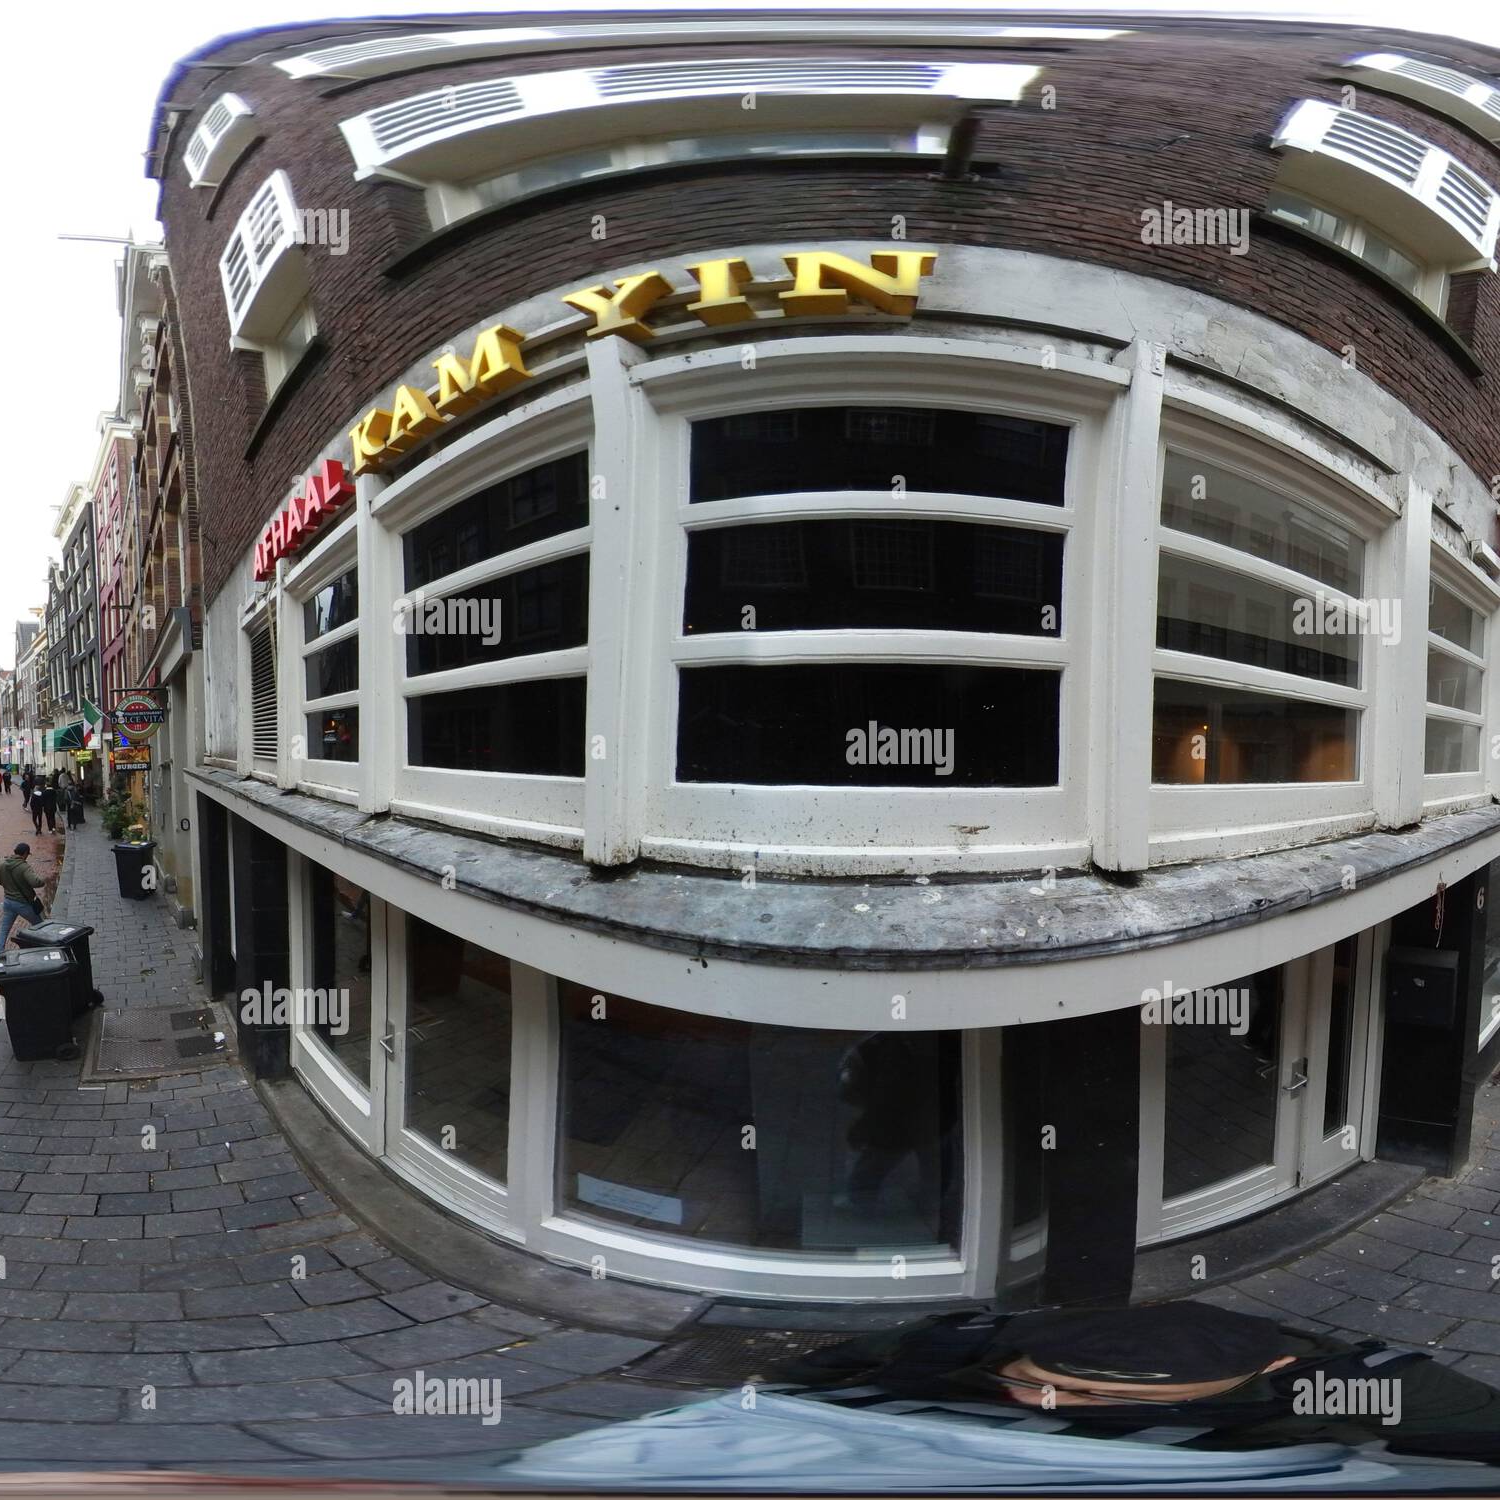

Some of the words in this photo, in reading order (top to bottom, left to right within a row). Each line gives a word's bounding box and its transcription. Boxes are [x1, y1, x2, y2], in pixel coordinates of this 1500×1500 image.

[349, 324, 535, 474] KAM
[562, 250, 938, 340] YIN
[252, 458, 355, 582] AFHAAL
[143, 715, 164, 723] VITA
[1476, 886, 1485, 910] 6
